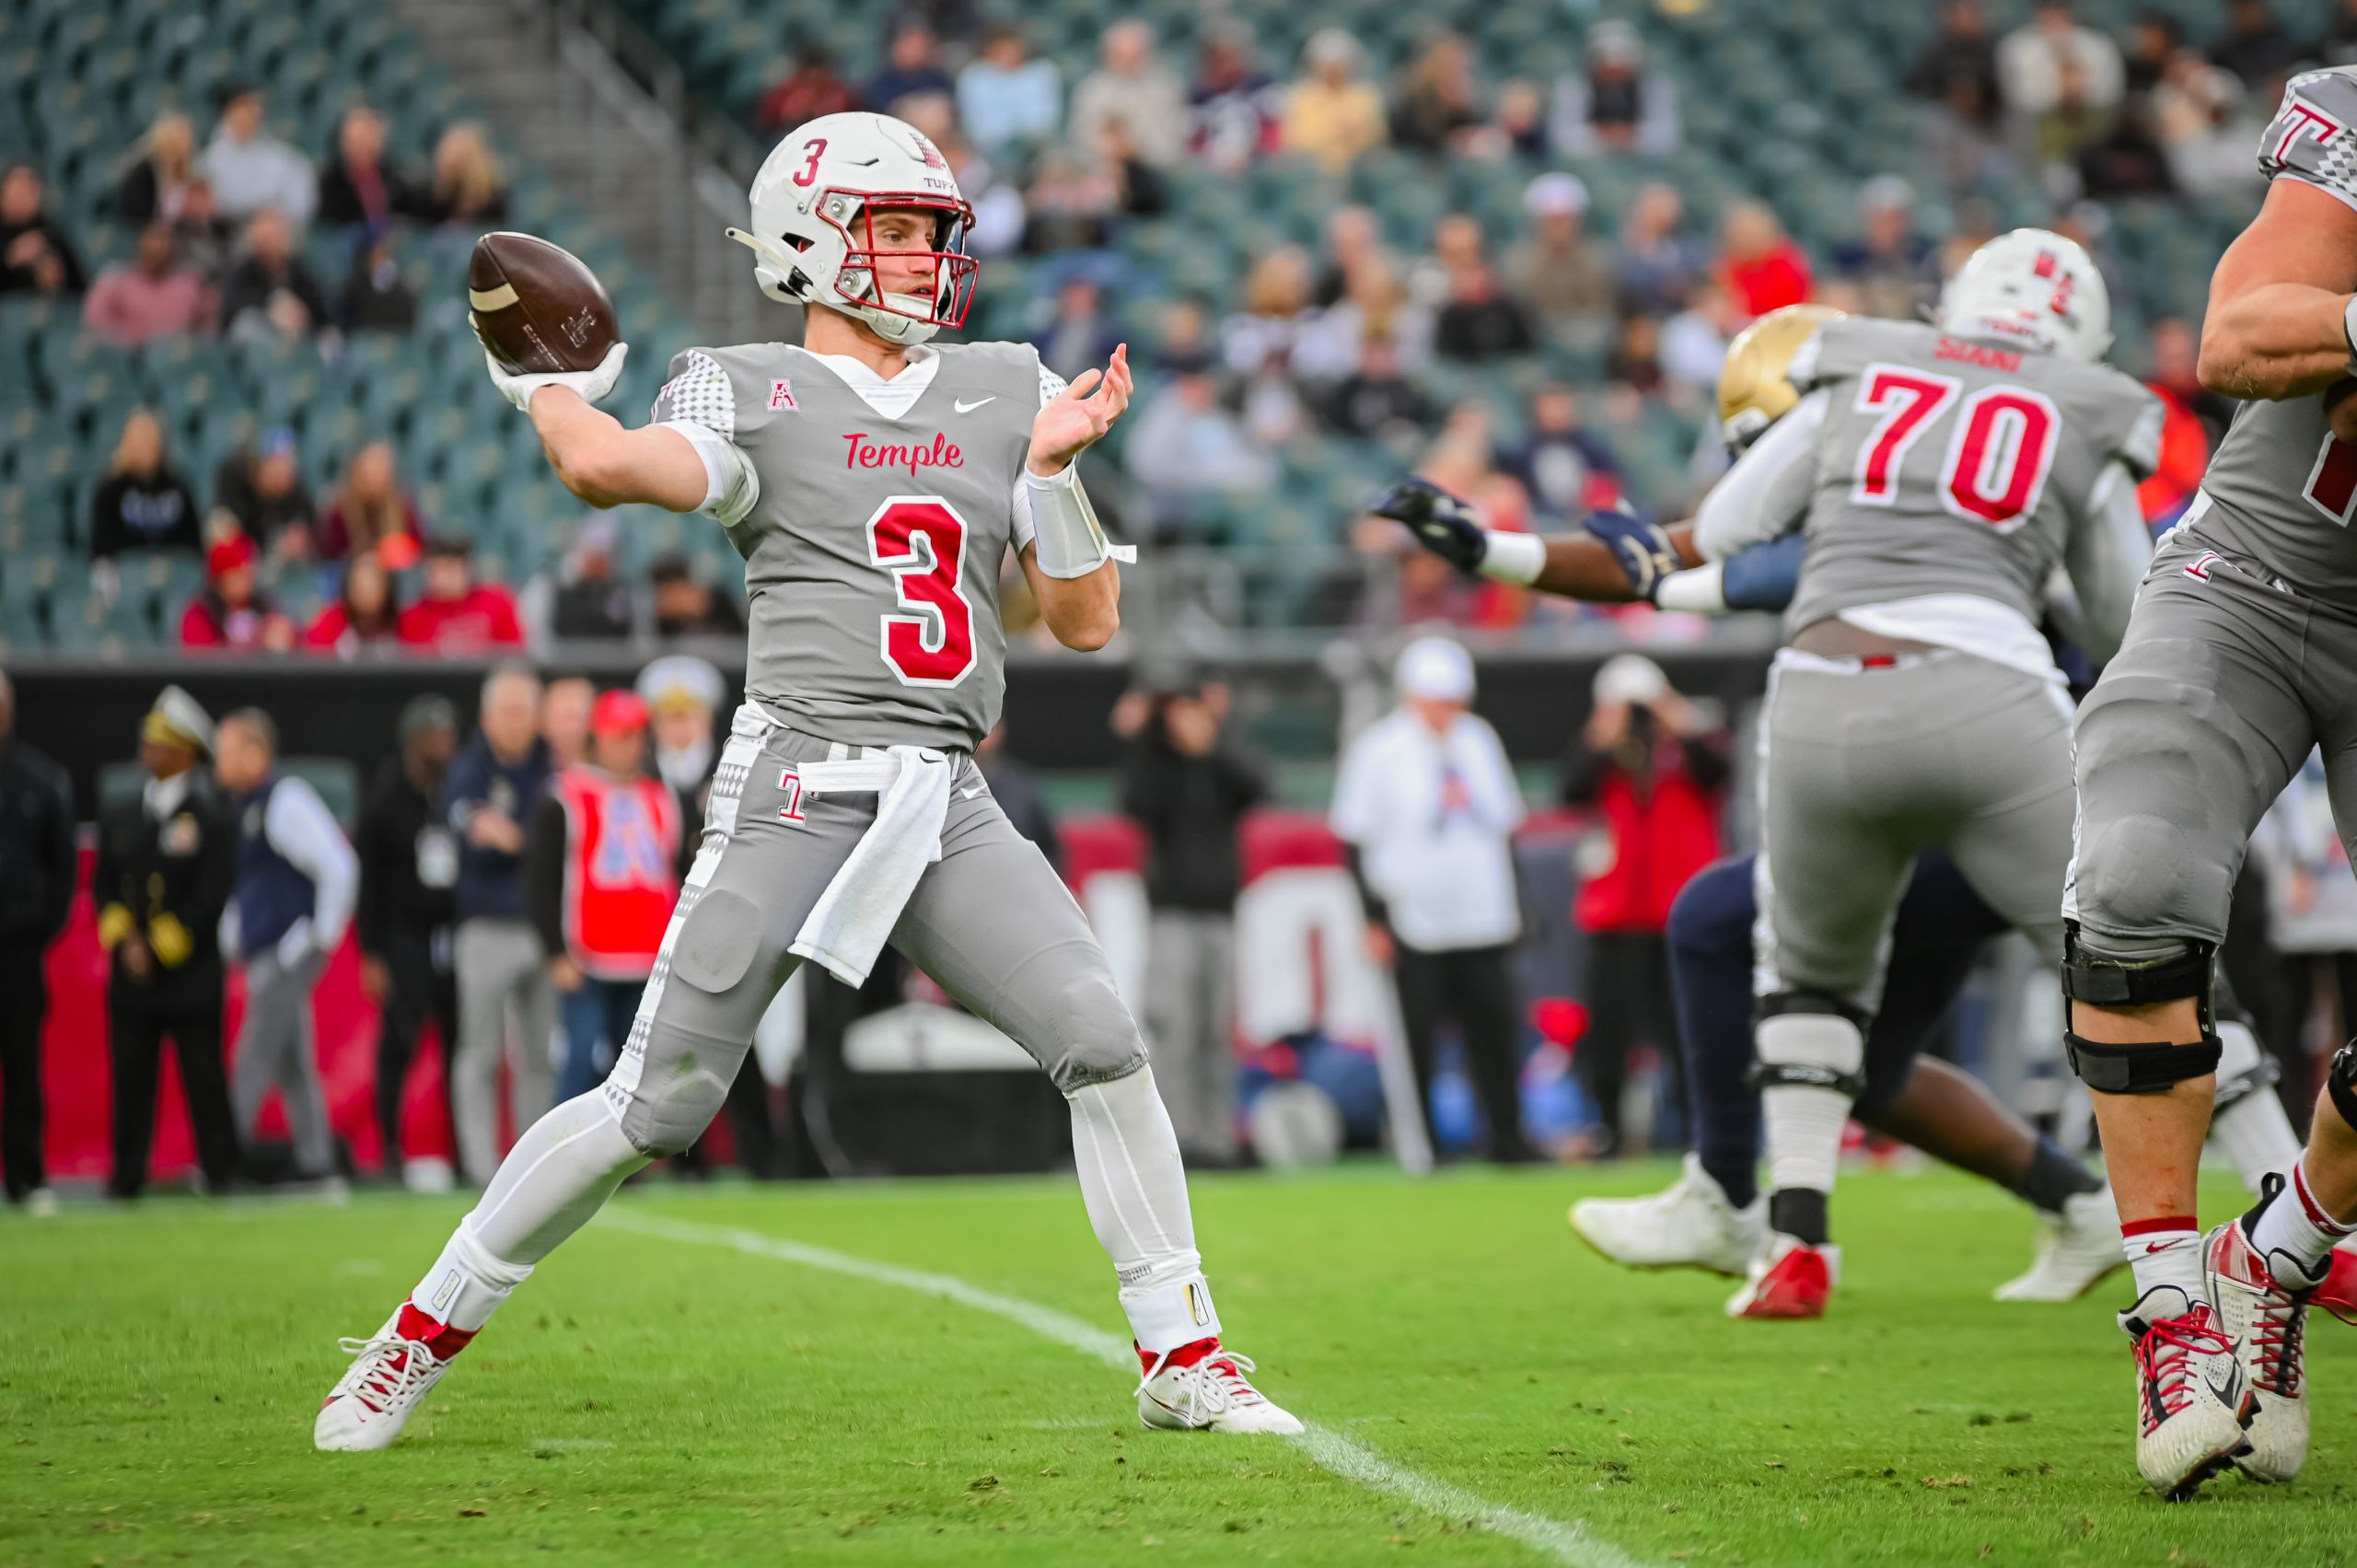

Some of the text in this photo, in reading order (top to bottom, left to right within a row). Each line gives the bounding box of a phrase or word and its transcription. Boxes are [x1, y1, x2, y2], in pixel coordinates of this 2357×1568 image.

[793, 138, 828, 187] 3
[767, 377, 799, 412] A
[842, 432, 963, 478] Temple
[1853, 365, 2061, 532] 70
[866, 495, 978, 689] 3
